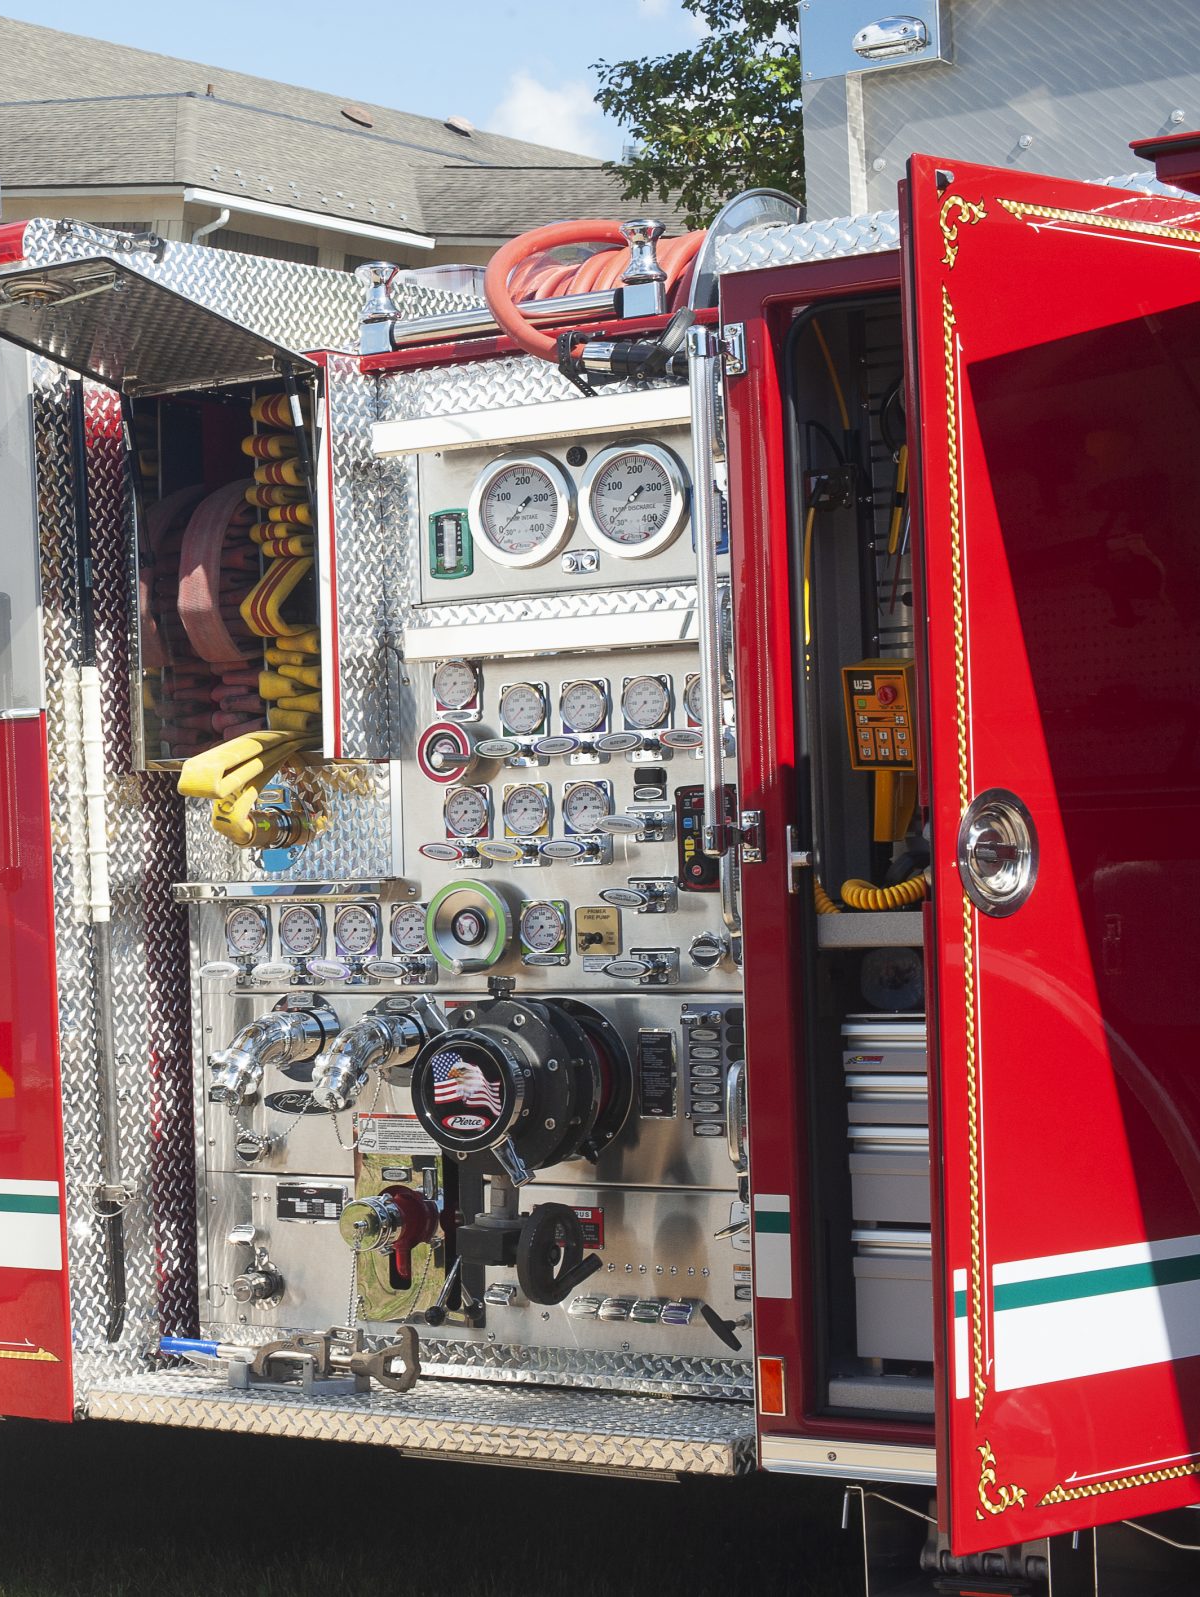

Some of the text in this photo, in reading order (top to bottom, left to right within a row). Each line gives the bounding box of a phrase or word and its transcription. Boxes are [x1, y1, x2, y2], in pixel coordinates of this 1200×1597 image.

[626, 465, 642, 474] 200
[515, 476, 531, 486] 200
[607, 481, 622, 490] 100
[646, 482, 662, 492] 300
[496, 492, 511, 501] 100
[533, 493, 549, 503] 300
[641, 513, 658, 523] 400
[529, 523, 545, 533] 400
[451, 1117, 480, 1126] Pierce
